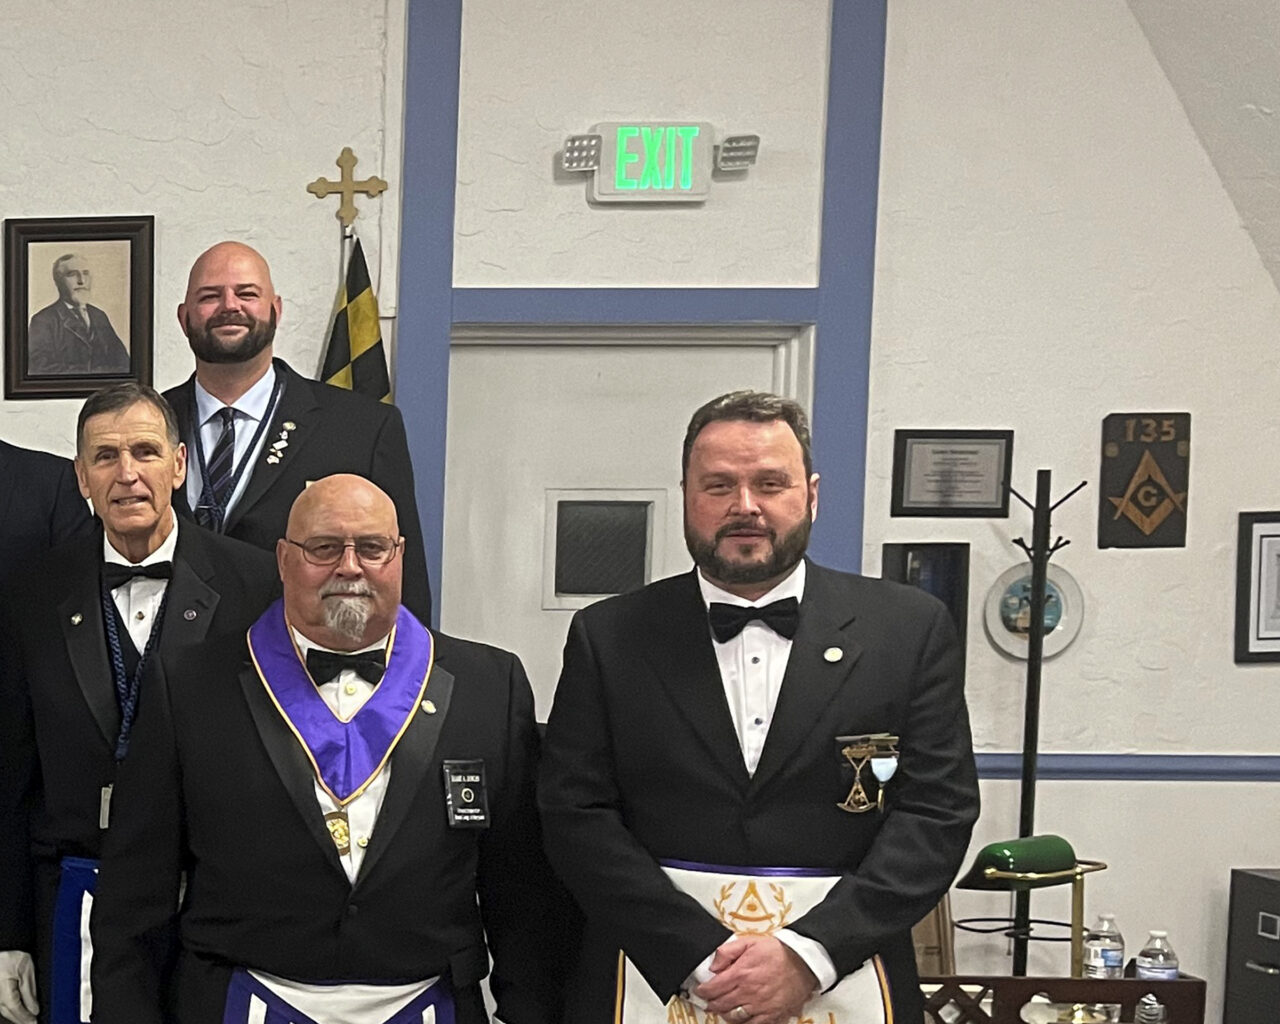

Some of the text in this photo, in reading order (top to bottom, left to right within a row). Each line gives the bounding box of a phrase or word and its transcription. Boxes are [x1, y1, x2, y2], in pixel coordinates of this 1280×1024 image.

[616, 127, 699, 190] EXIT
[1125, 418, 1176, 443] 135
[1137, 485, 1159, 508] G
